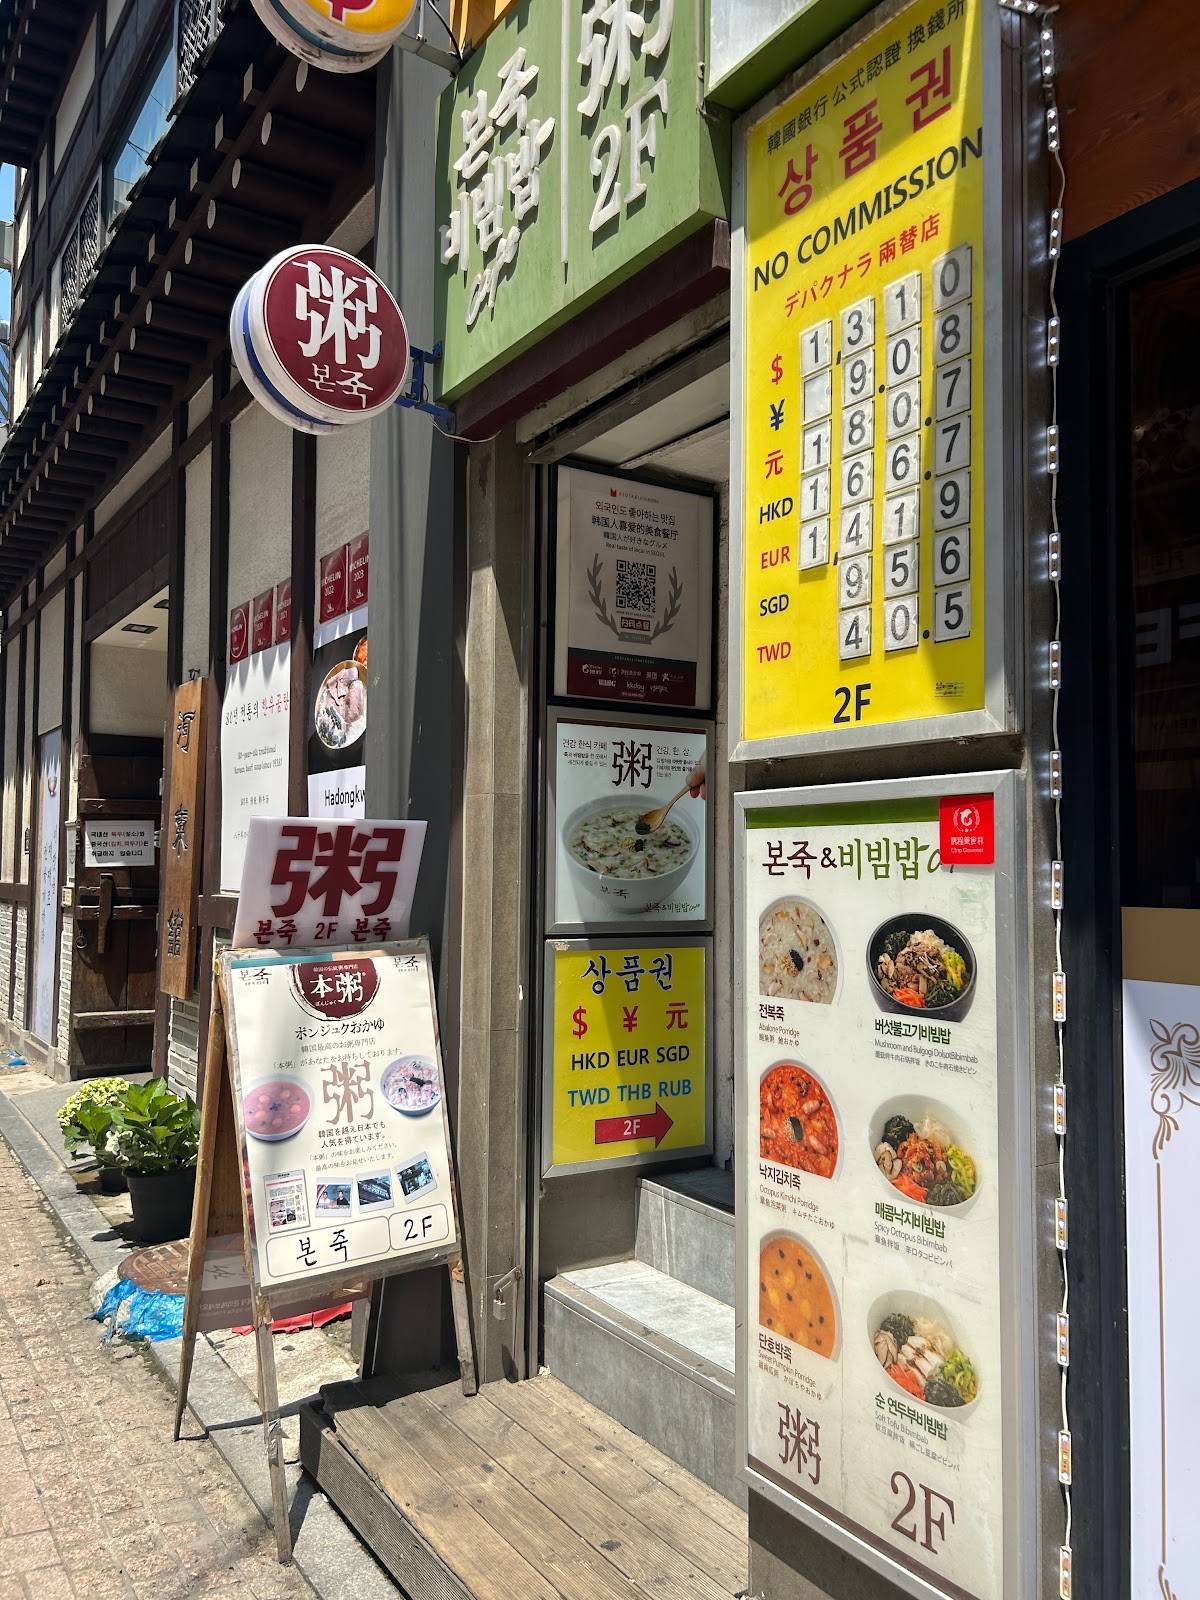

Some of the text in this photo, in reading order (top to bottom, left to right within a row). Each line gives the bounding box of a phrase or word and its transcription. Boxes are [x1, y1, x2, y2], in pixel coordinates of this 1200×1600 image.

[767, 1, 965, 155] 韓國銀行 公式認證 換錢所
[453, 46, 540, 180] 본죽
[589, 78, 669, 232] 2F
[440, 117, 556, 272] 비빔밥
[753, 127, 983, 291] NO COMMISSION
[878, 213, 941, 267] 兩替店
[291, 260, 382, 370] 粥
[771, 353, 784, 385] $
[307, 362, 374, 409] 본죽
[770, 399, 785, 431] ¥
[765, 449, 784, 479] 元
[595, 501, 627, 516] 외국인도
[660, 514, 676, 526] 맛집
[759, 497, 794, 525] HKD
[760, 545, 791, 570] EUR
[759, 594, 790, 617] SGD
[757, 641, 792, 664] TWD
[833, 683, 872, 724] 2F
[611, 739, 654, 789] 粥
[270, 825, 407, 918] 粥
[253, 919, 298, 945] 본죽
[314, 922, 339, 941] 2F
[350, 917, 392, 942] 본죽
[309, 971, 364, 1004] 本粥
[581, 953, 674, 995] 상품권
[572, 1002, 689, 1040] $ ¥ 元
[759, 1003, 785, 1022] 전복죽
[778, 1025, 800, 1038] Porridge
[874, 1018, 951, 1045] 버섯불고기비빔밥
[874, 1038, 902, 1051] Mushroom
[902, 1044, 913, 1053] and
[571, 1045, 690, 1071] HKD EUR SGD
[320, 1060, 374, 1125] 粥
[567, 1079, 692, 1107] TWD THB RUB
[623, 1119, 641, 1136] 2F
[759, 1164, 801, 1191] 낙지김치죽
[404, 1215, 433, 1241] 2F
[875, 1202, 946, 1239] 매콤낙지비빔밥
[874, 1221, 948, 1254] Spicy Octopus Bibimbab
[758, 1332, 792, 1365] 단호박죽
[794, 1368, 817, 1388] Porridge
[874, 1392, 949, 1441] 순 연두부비빔밥
[886, 1416, 900, 1431] Tofu
[900, 1423, 929, 1446] Bibimbab
[777, 1400, 822, 1485] 粥
[890, 1470, 955, 1555] 2F
